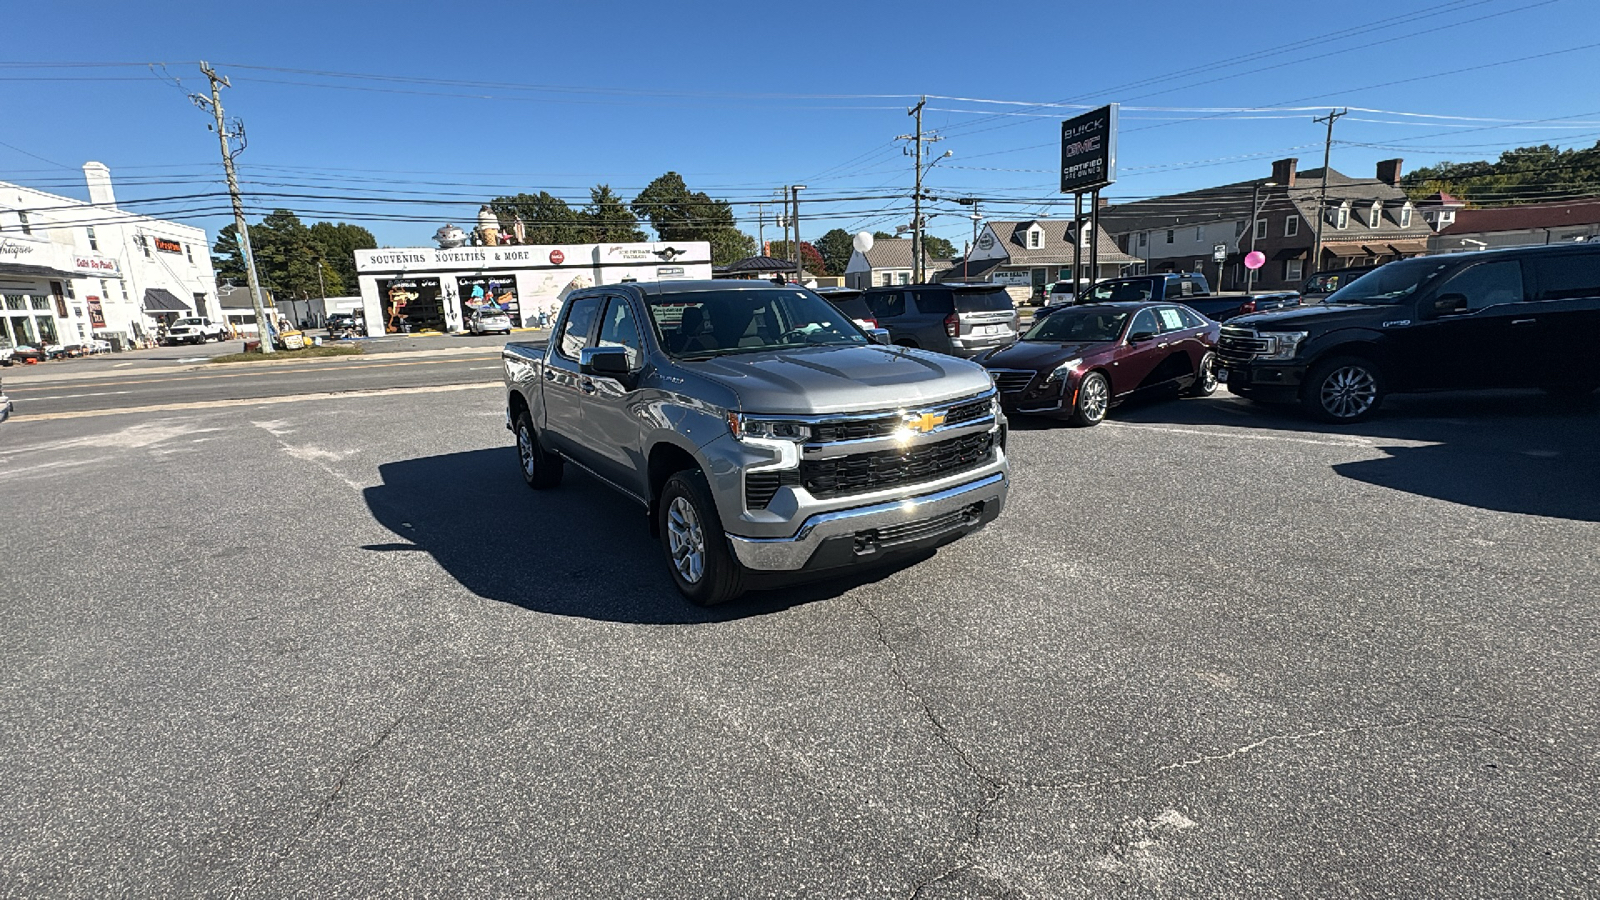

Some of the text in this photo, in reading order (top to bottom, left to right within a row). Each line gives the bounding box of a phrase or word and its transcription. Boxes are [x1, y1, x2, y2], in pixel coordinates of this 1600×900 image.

[1064, 118, 1103, 139] BUICK
[1066, 135, 1100, 157] GMC
[1063, 158, 1102, 174] CERTIFIED
[370, 251, 529, 264] SOUVENIRS NOVELTIES & MORE
